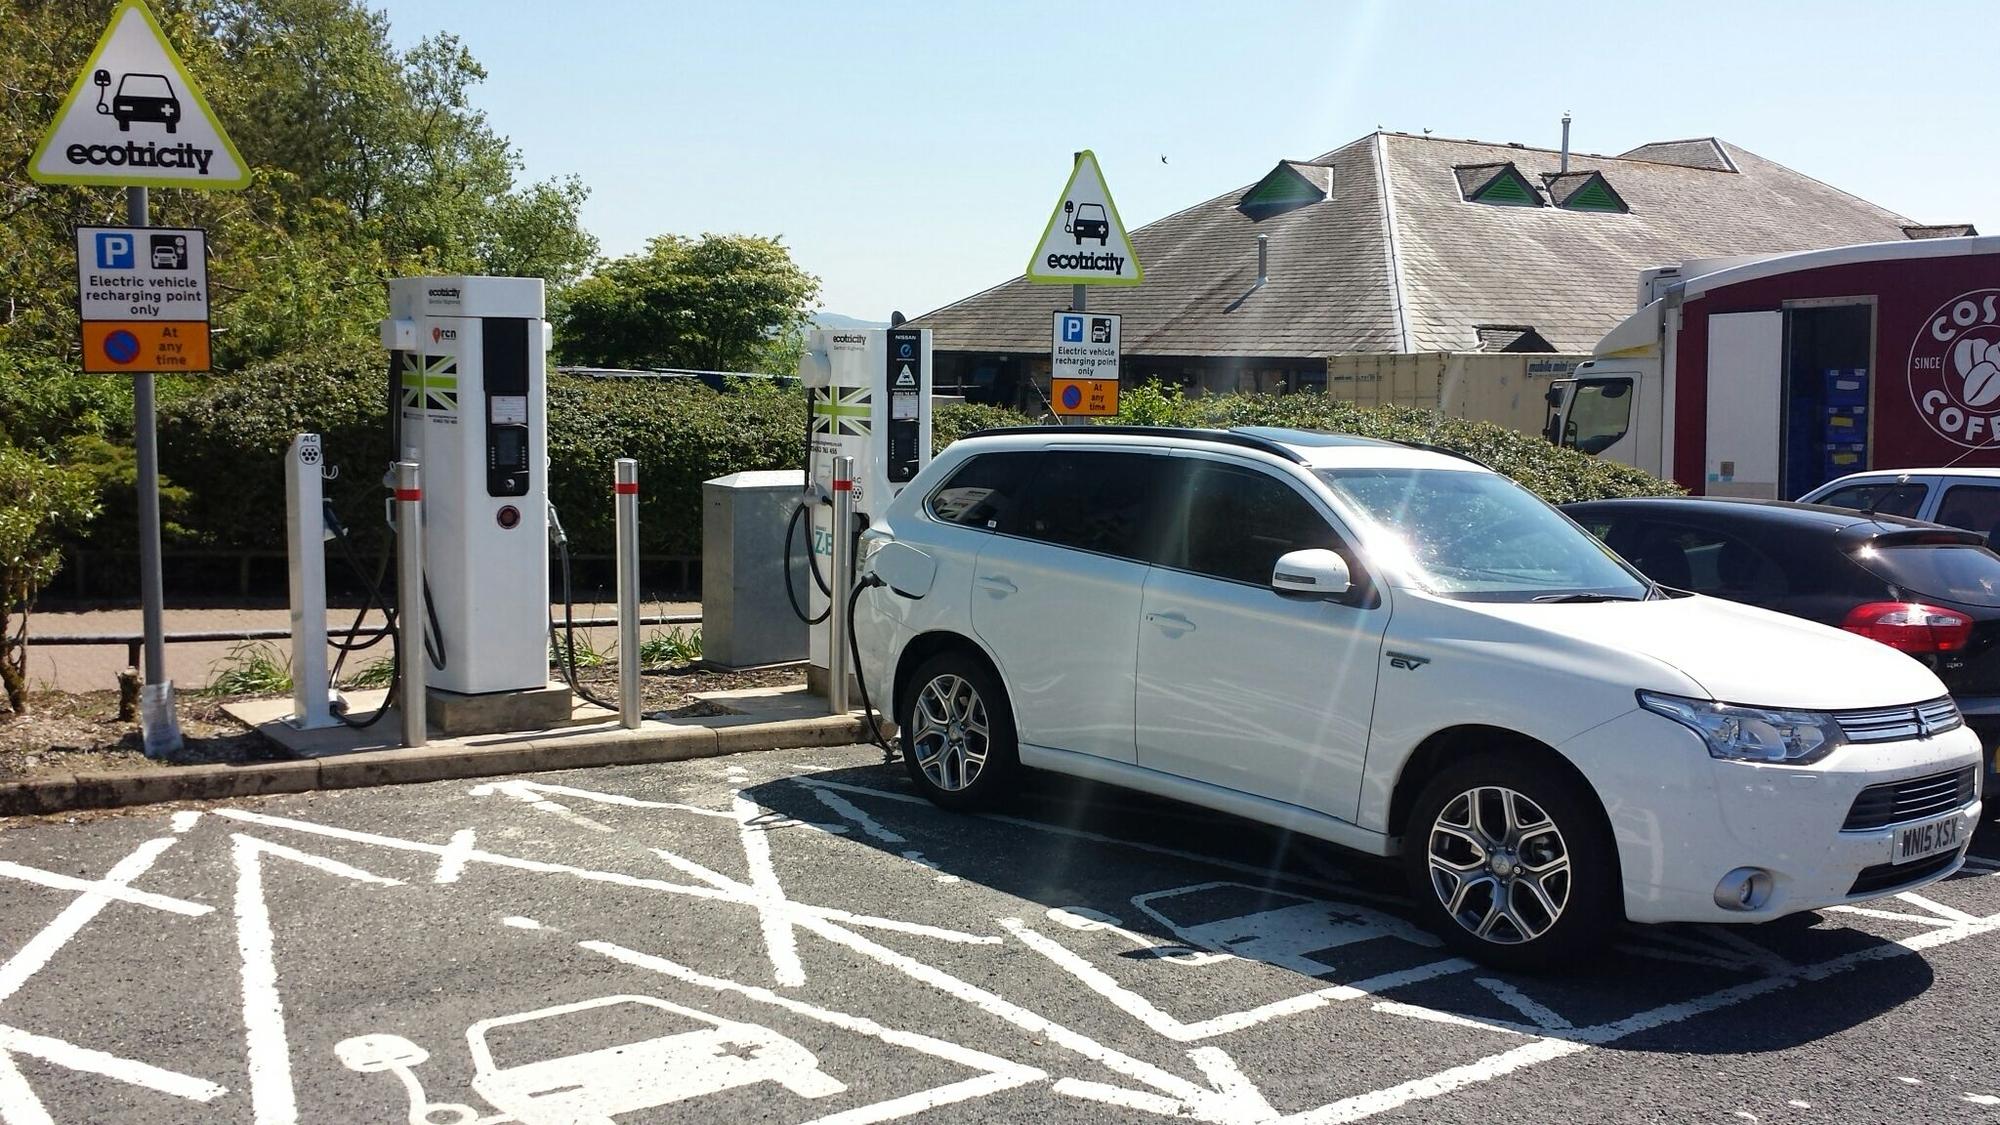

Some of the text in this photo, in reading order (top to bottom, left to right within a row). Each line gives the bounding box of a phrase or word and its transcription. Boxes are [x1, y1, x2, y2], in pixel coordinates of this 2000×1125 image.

[66, 141, 214, 175] ecotricity
[104, 237, 129, 266] P
[1047, 251, 1124, 275] ecotricity
[90, 275, 198, 288] Electric vehicle
[86, 291, 202, 303] recharging point
[130, 304, 160, 317] only
[162, 327, 178, 338] At
[1067, 319, 1081, 340] P
[832, 334, 867, 346] ecotricity
[158, 341, 183, 353] any
[1058, 346, 1115, 357] Electric vehicle
[155, 354, 187, 366] time
[1055, 357, 1117, 367] recharging point
[1914, 356, 1941, 370] SINCE
[1078, 367, 1094, 377] only
[1093, 383, 1103, 392] At
[1090, 394, 1105, 403] any
[1089, 404, 1106, 412] time
[302, 435, 318, 443] AC
[1902, 816, 1958, 858] WN15 XSX
